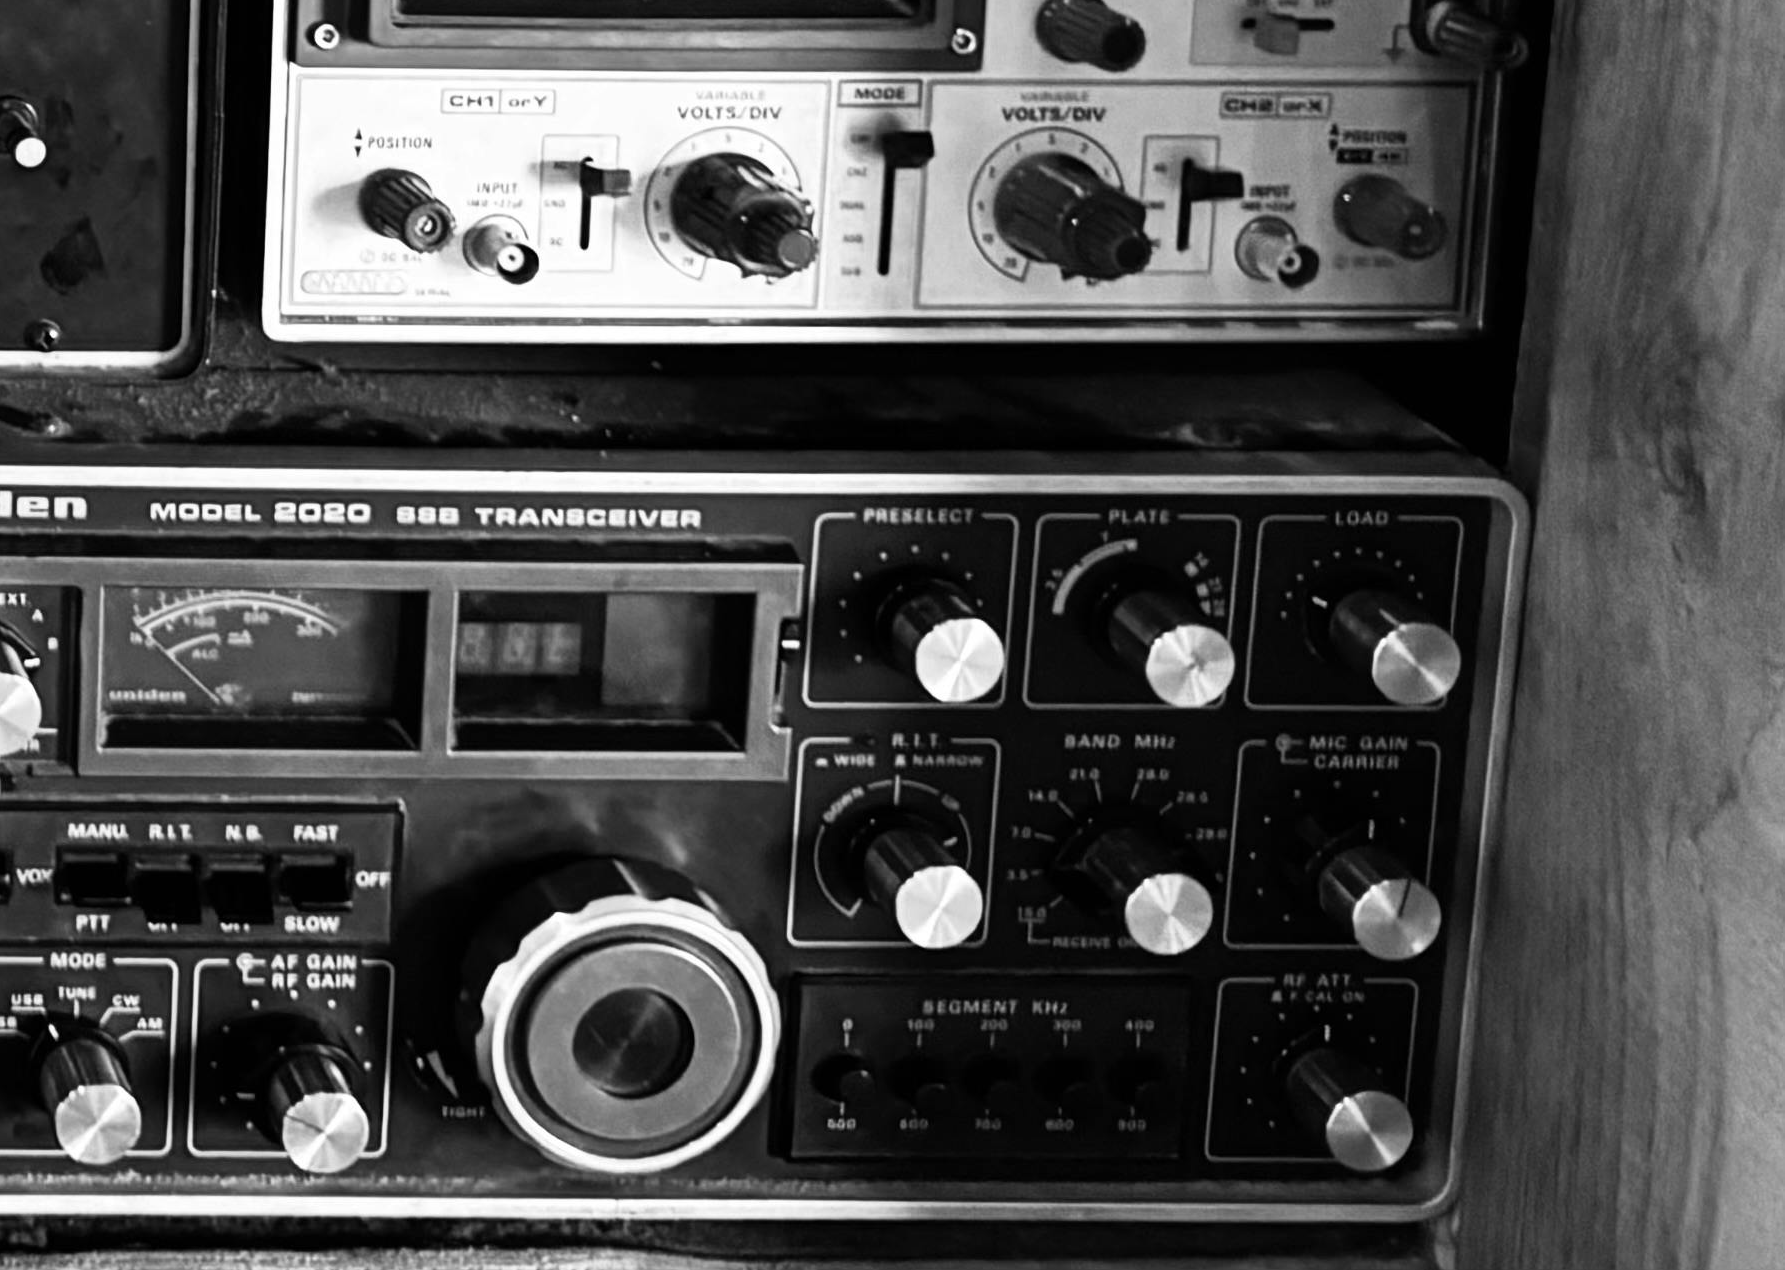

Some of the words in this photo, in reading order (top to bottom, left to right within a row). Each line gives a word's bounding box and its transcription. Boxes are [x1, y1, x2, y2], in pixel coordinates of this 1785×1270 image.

[368, 137, 432, 148] POSITION
[151, 503, 261, 521] MODEL
[274, 503, 370, 523] 2020
[475, 508, 701, 527] TRANSCEIVER
[864, 508, 970, 523] PRESELECT
[1109, 510, 1168, 523] PLATE
[1336, 511, 1388, 525] LOAD
[1065, 735, 1120, 748] BAND
[1315, 755, 1398, 768] CARRIER
[294, 826, 338, 840] FAST
[285, 916, 339, 932] SLOW
[51, 953, 105, 968] MODE
